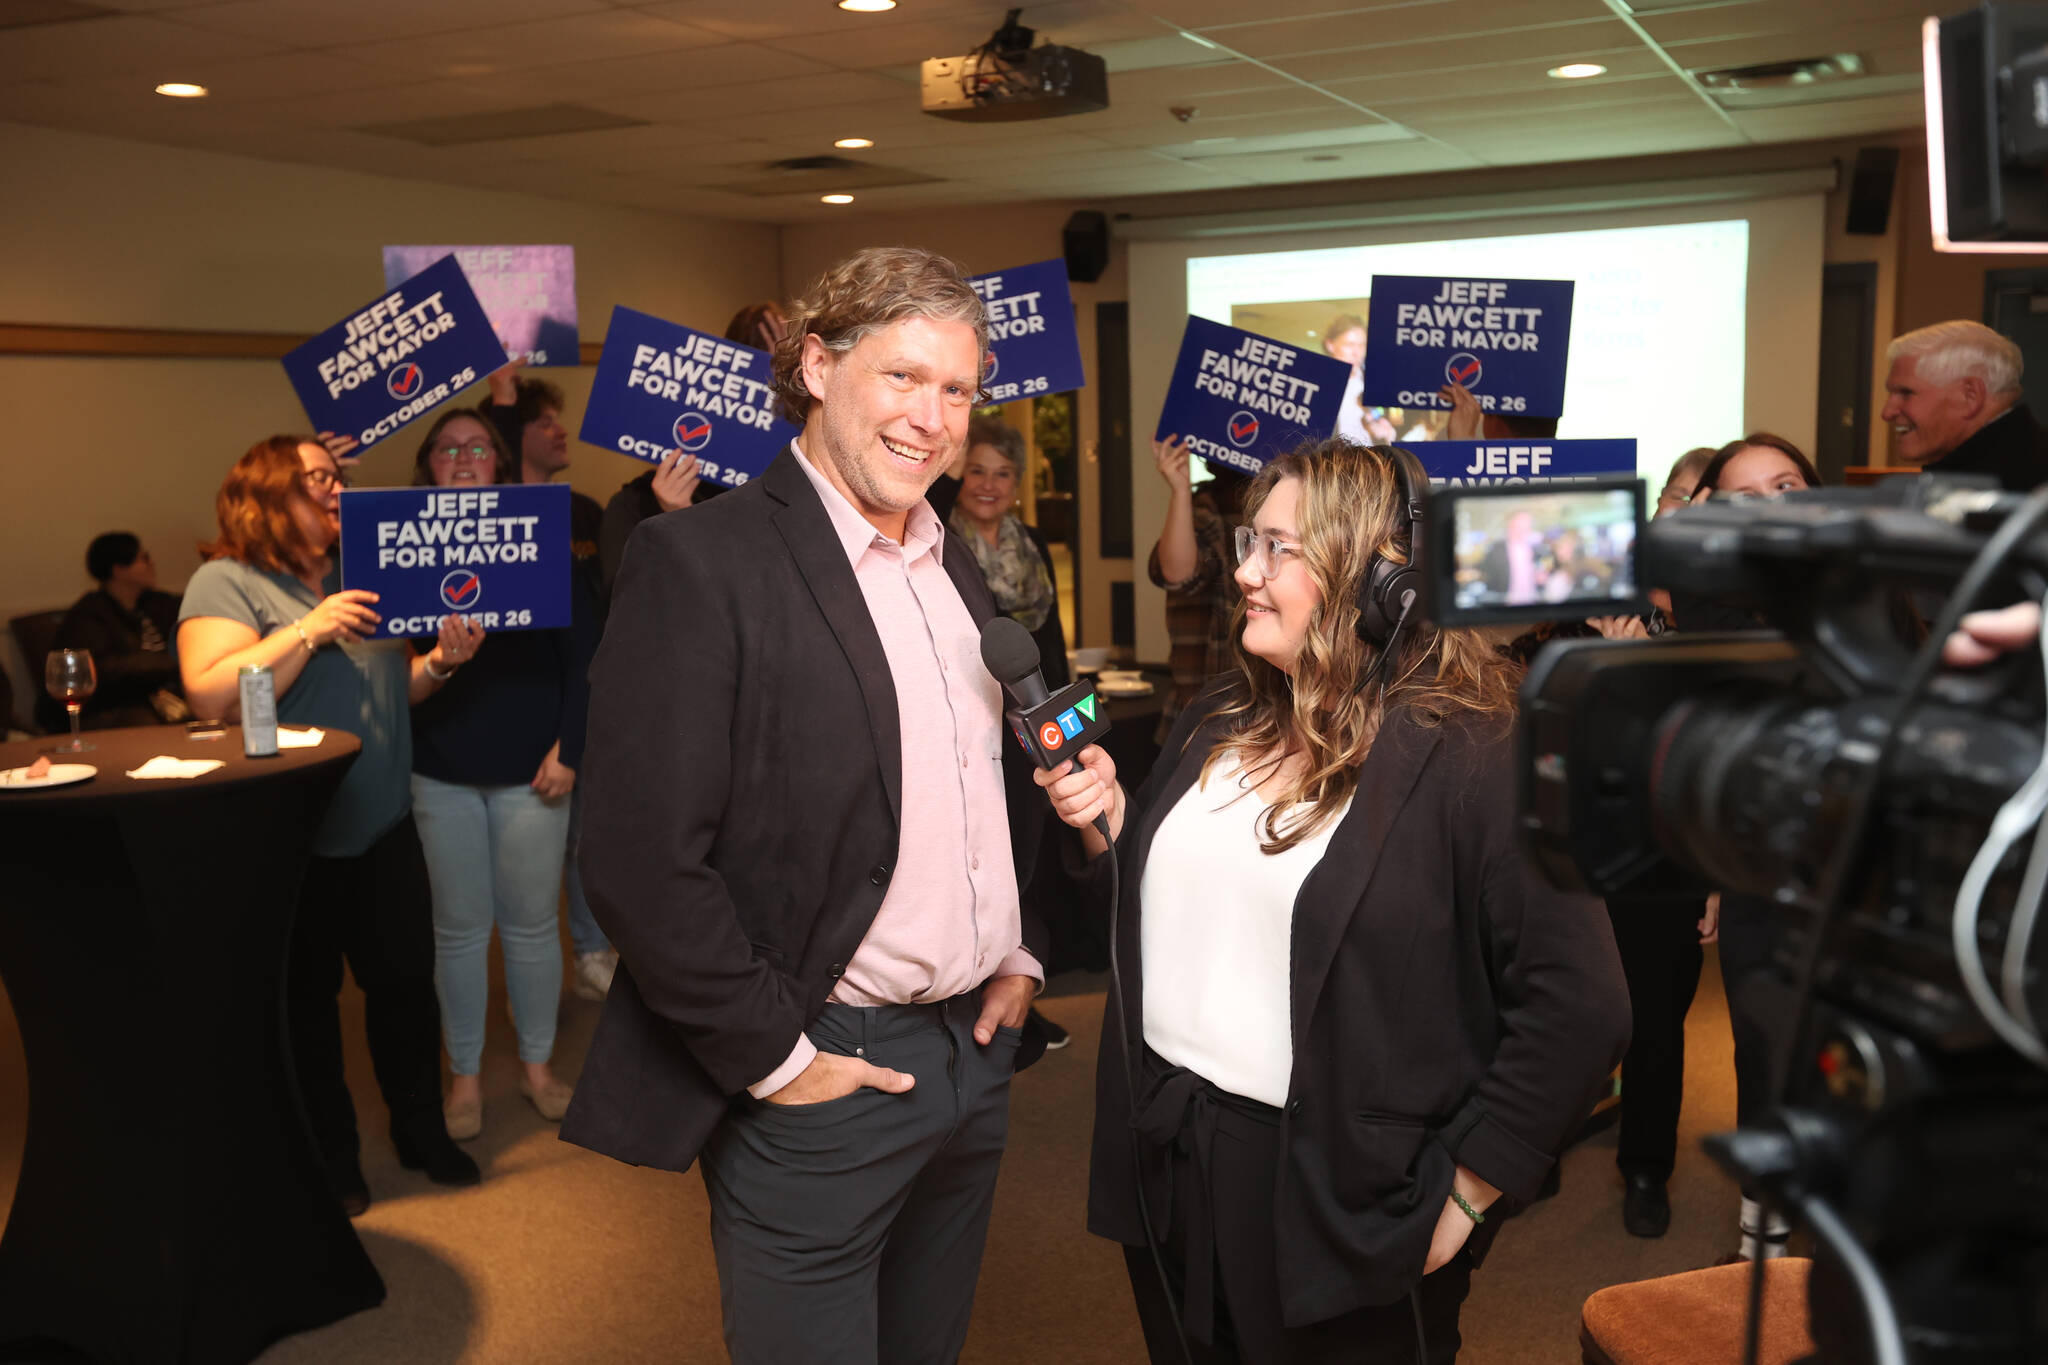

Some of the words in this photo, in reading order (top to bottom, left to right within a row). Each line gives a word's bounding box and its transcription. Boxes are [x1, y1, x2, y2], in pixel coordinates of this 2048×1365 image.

[968, 276, 1003, 299] FF
[1434, 281, 1507, 305] JEFF
[344, 292, 404, 345] JEFF
[987, 315, 1046, 341] AYOR
[1397, 304, 1542, 331] FAWCETT
[318, 291, 444, 384] FAWCETT
[1396, 328, 1446, 348] FOR
[1451, 331, 1539, 352] MAYOR
[327, 360, 377, 400] FOR
[376, 312, 456, 371] MAYOR
[676, 334, 753, 373] JEFF
[1234, 337, 1297, 371] JEFF
[632, 344, 776, 410] FAWCETT
[1023, 376, 1049, 394] 26
[1200, 349, 1320, 405] FAWCETT
[361, 382, 449, 445] OCTOBER
[451, 366, 476, 392] 26
[627, 369, 681, 402] FOR
[685, 387, 774, 431] MAYOR
[1195, 372, 1237, 401] FOR
[1239, 388, 1311, 426] MAYOR
[1397, 391, 1496, 410] OCTR
[1501, 396, 1526, 412] 26
[1184, 434, 1263, 473] OCTOBER
[1466, 447, 1552, 475] JEFF
[721, 468, 749, 487] 26
[418, 492, 499, 519] JEFF
[377, 516, 539, 547] FAWCETT
[379, 547, 436, 569] FOR
[444, 543, 538, 566] MAYOR
[505, 609, 532, 627] 26
[1043, 699, 1093, 746] CTV
